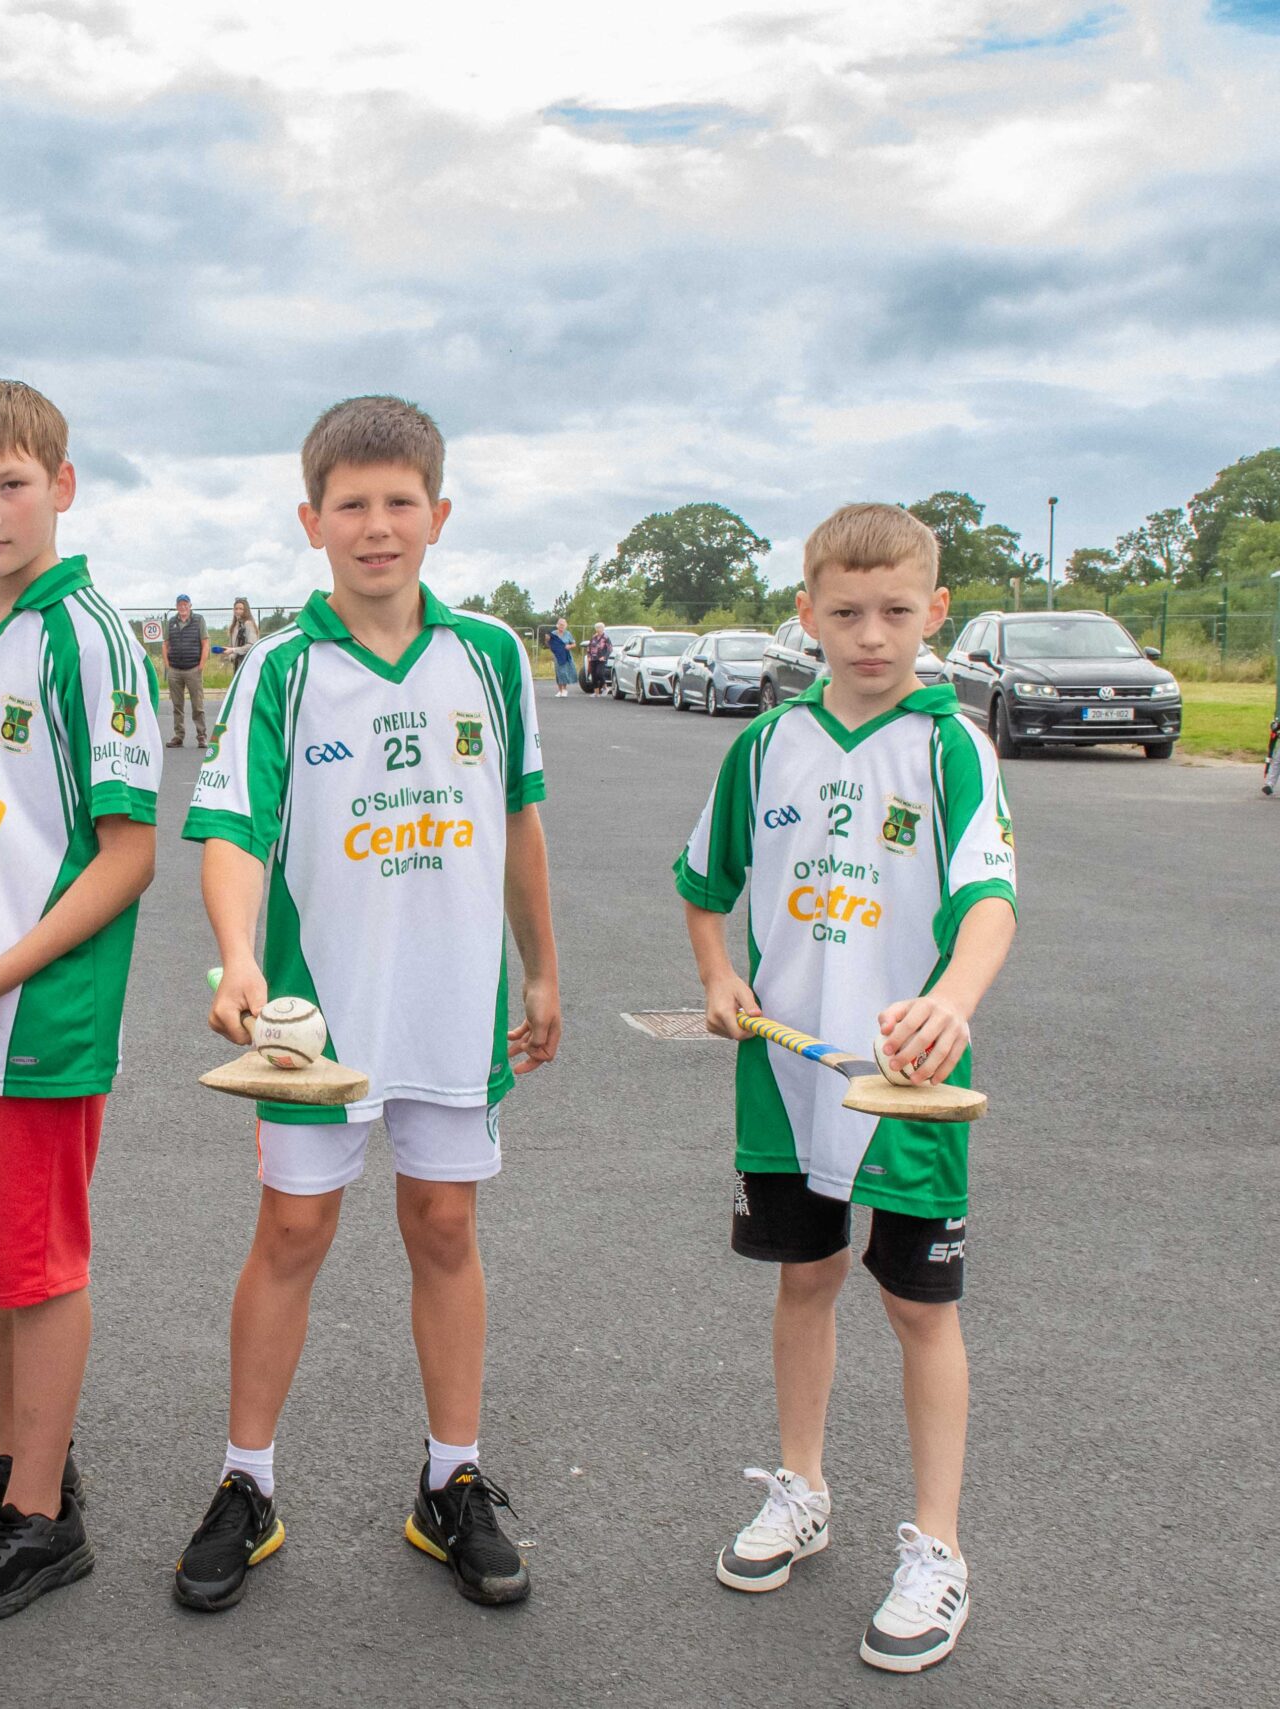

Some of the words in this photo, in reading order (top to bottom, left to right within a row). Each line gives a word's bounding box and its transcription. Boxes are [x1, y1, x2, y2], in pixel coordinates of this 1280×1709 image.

[147, 625, 157, 634] 20
[373, 711, 427, 735] O'NEILLS
[93, 741, 122, 762] BAIL
[383, 734, 421, 772] 25
[351, 785, 463, 817] O'Sullivan's
[343, 812, 474, 861] Centra
[380, 852, 443, 877] Clarina
